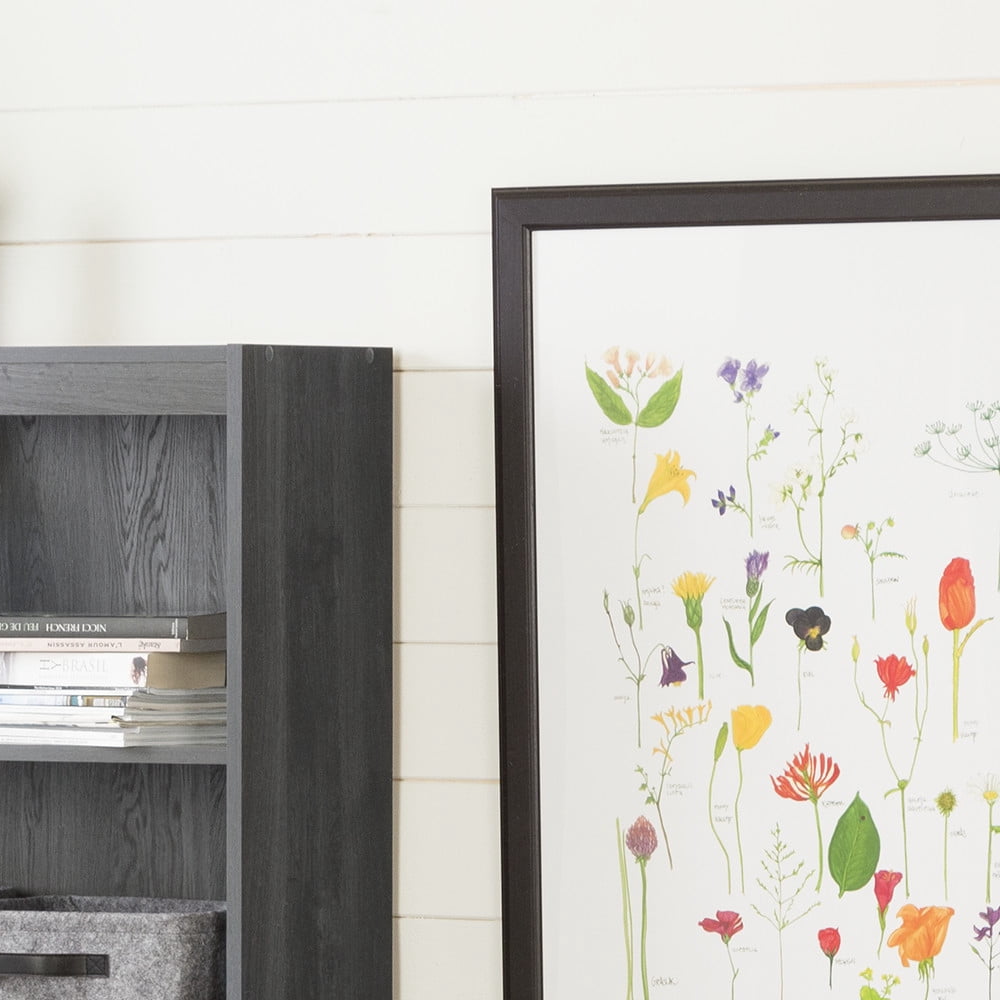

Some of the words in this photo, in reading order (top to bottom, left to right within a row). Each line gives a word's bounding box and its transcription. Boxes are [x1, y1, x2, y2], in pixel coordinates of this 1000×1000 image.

[9, 623, 22, 631] DE
[24, 623, 39, 631] FEU
[46, 623, 80, 632] FRENCH
[81, 623, 107, 632] NICCI
